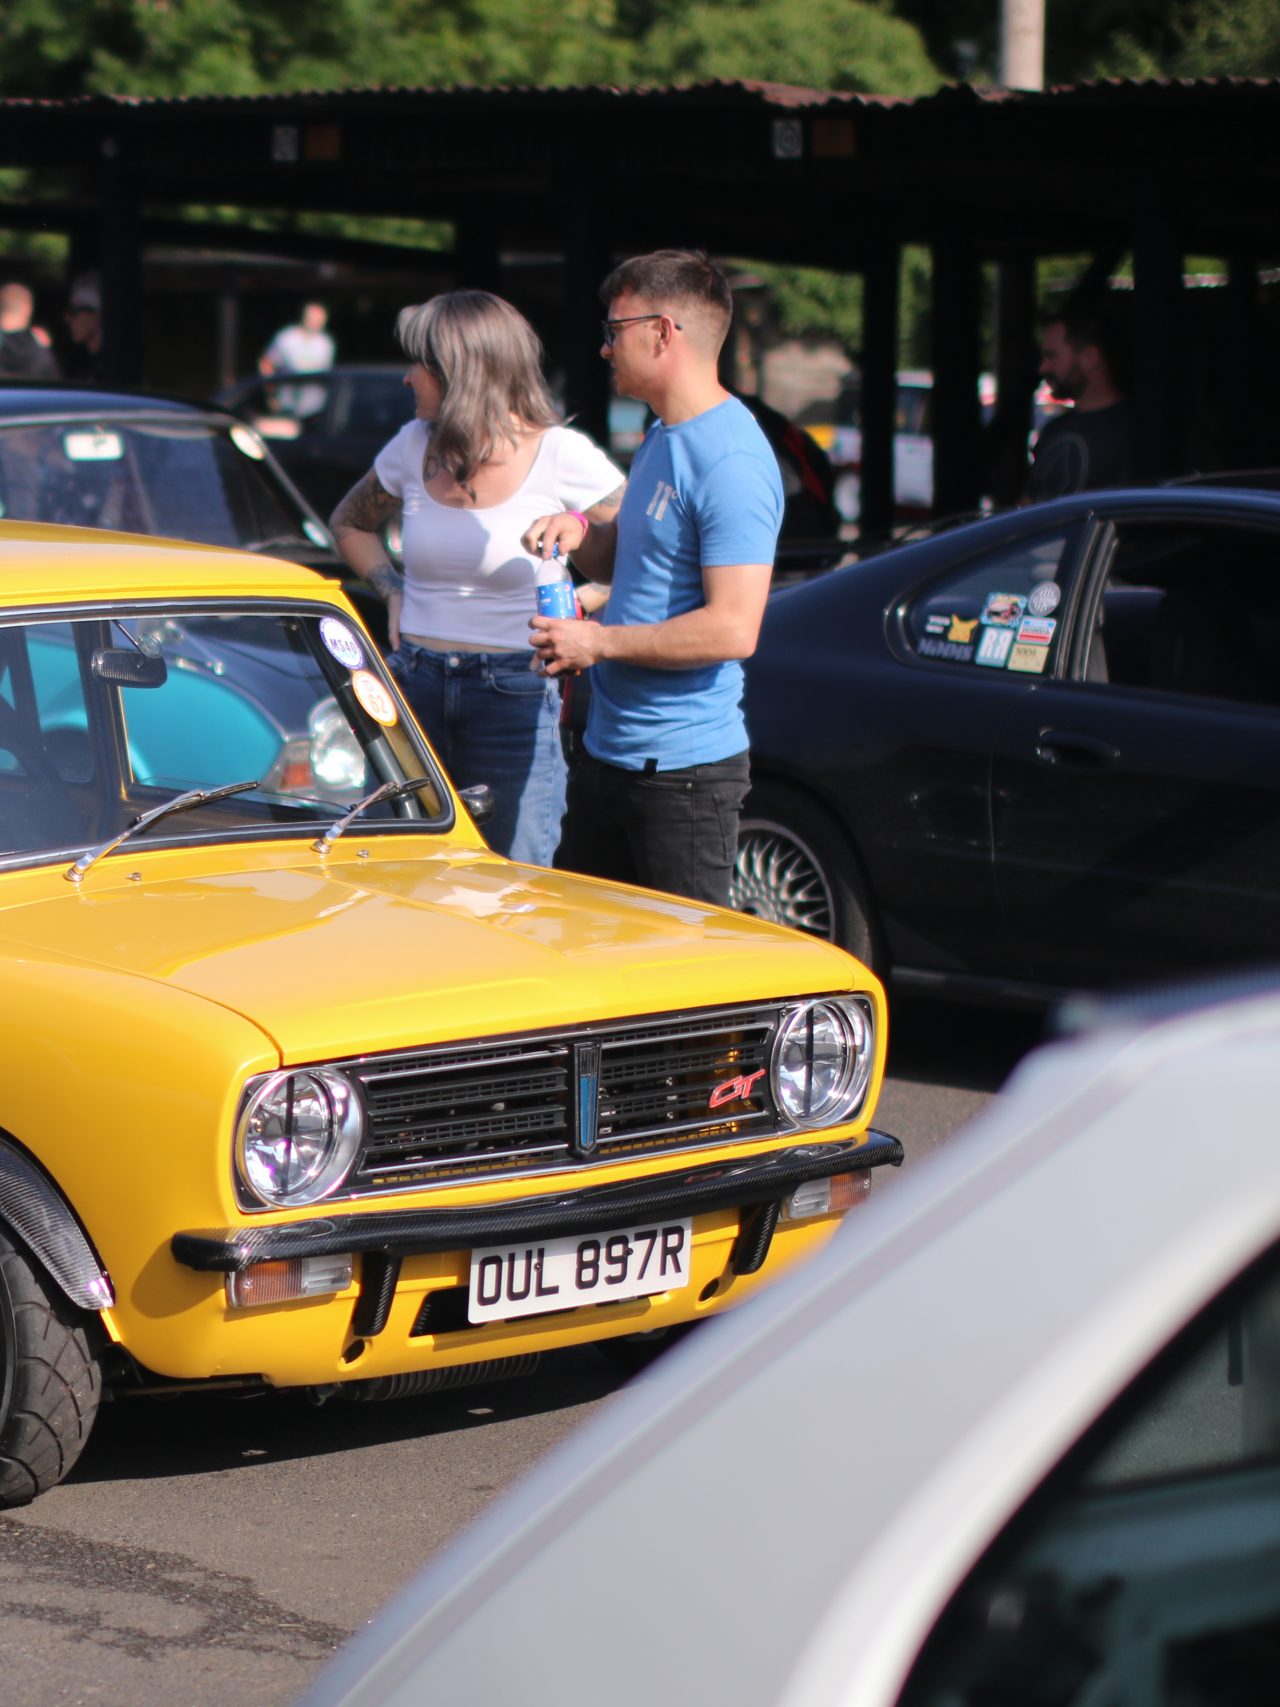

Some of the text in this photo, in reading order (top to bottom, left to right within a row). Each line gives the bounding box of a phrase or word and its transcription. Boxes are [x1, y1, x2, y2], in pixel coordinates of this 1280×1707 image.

[709, 1068, 766, 1108] GT
[477, 1225, 684, 1306] OUL 897R
